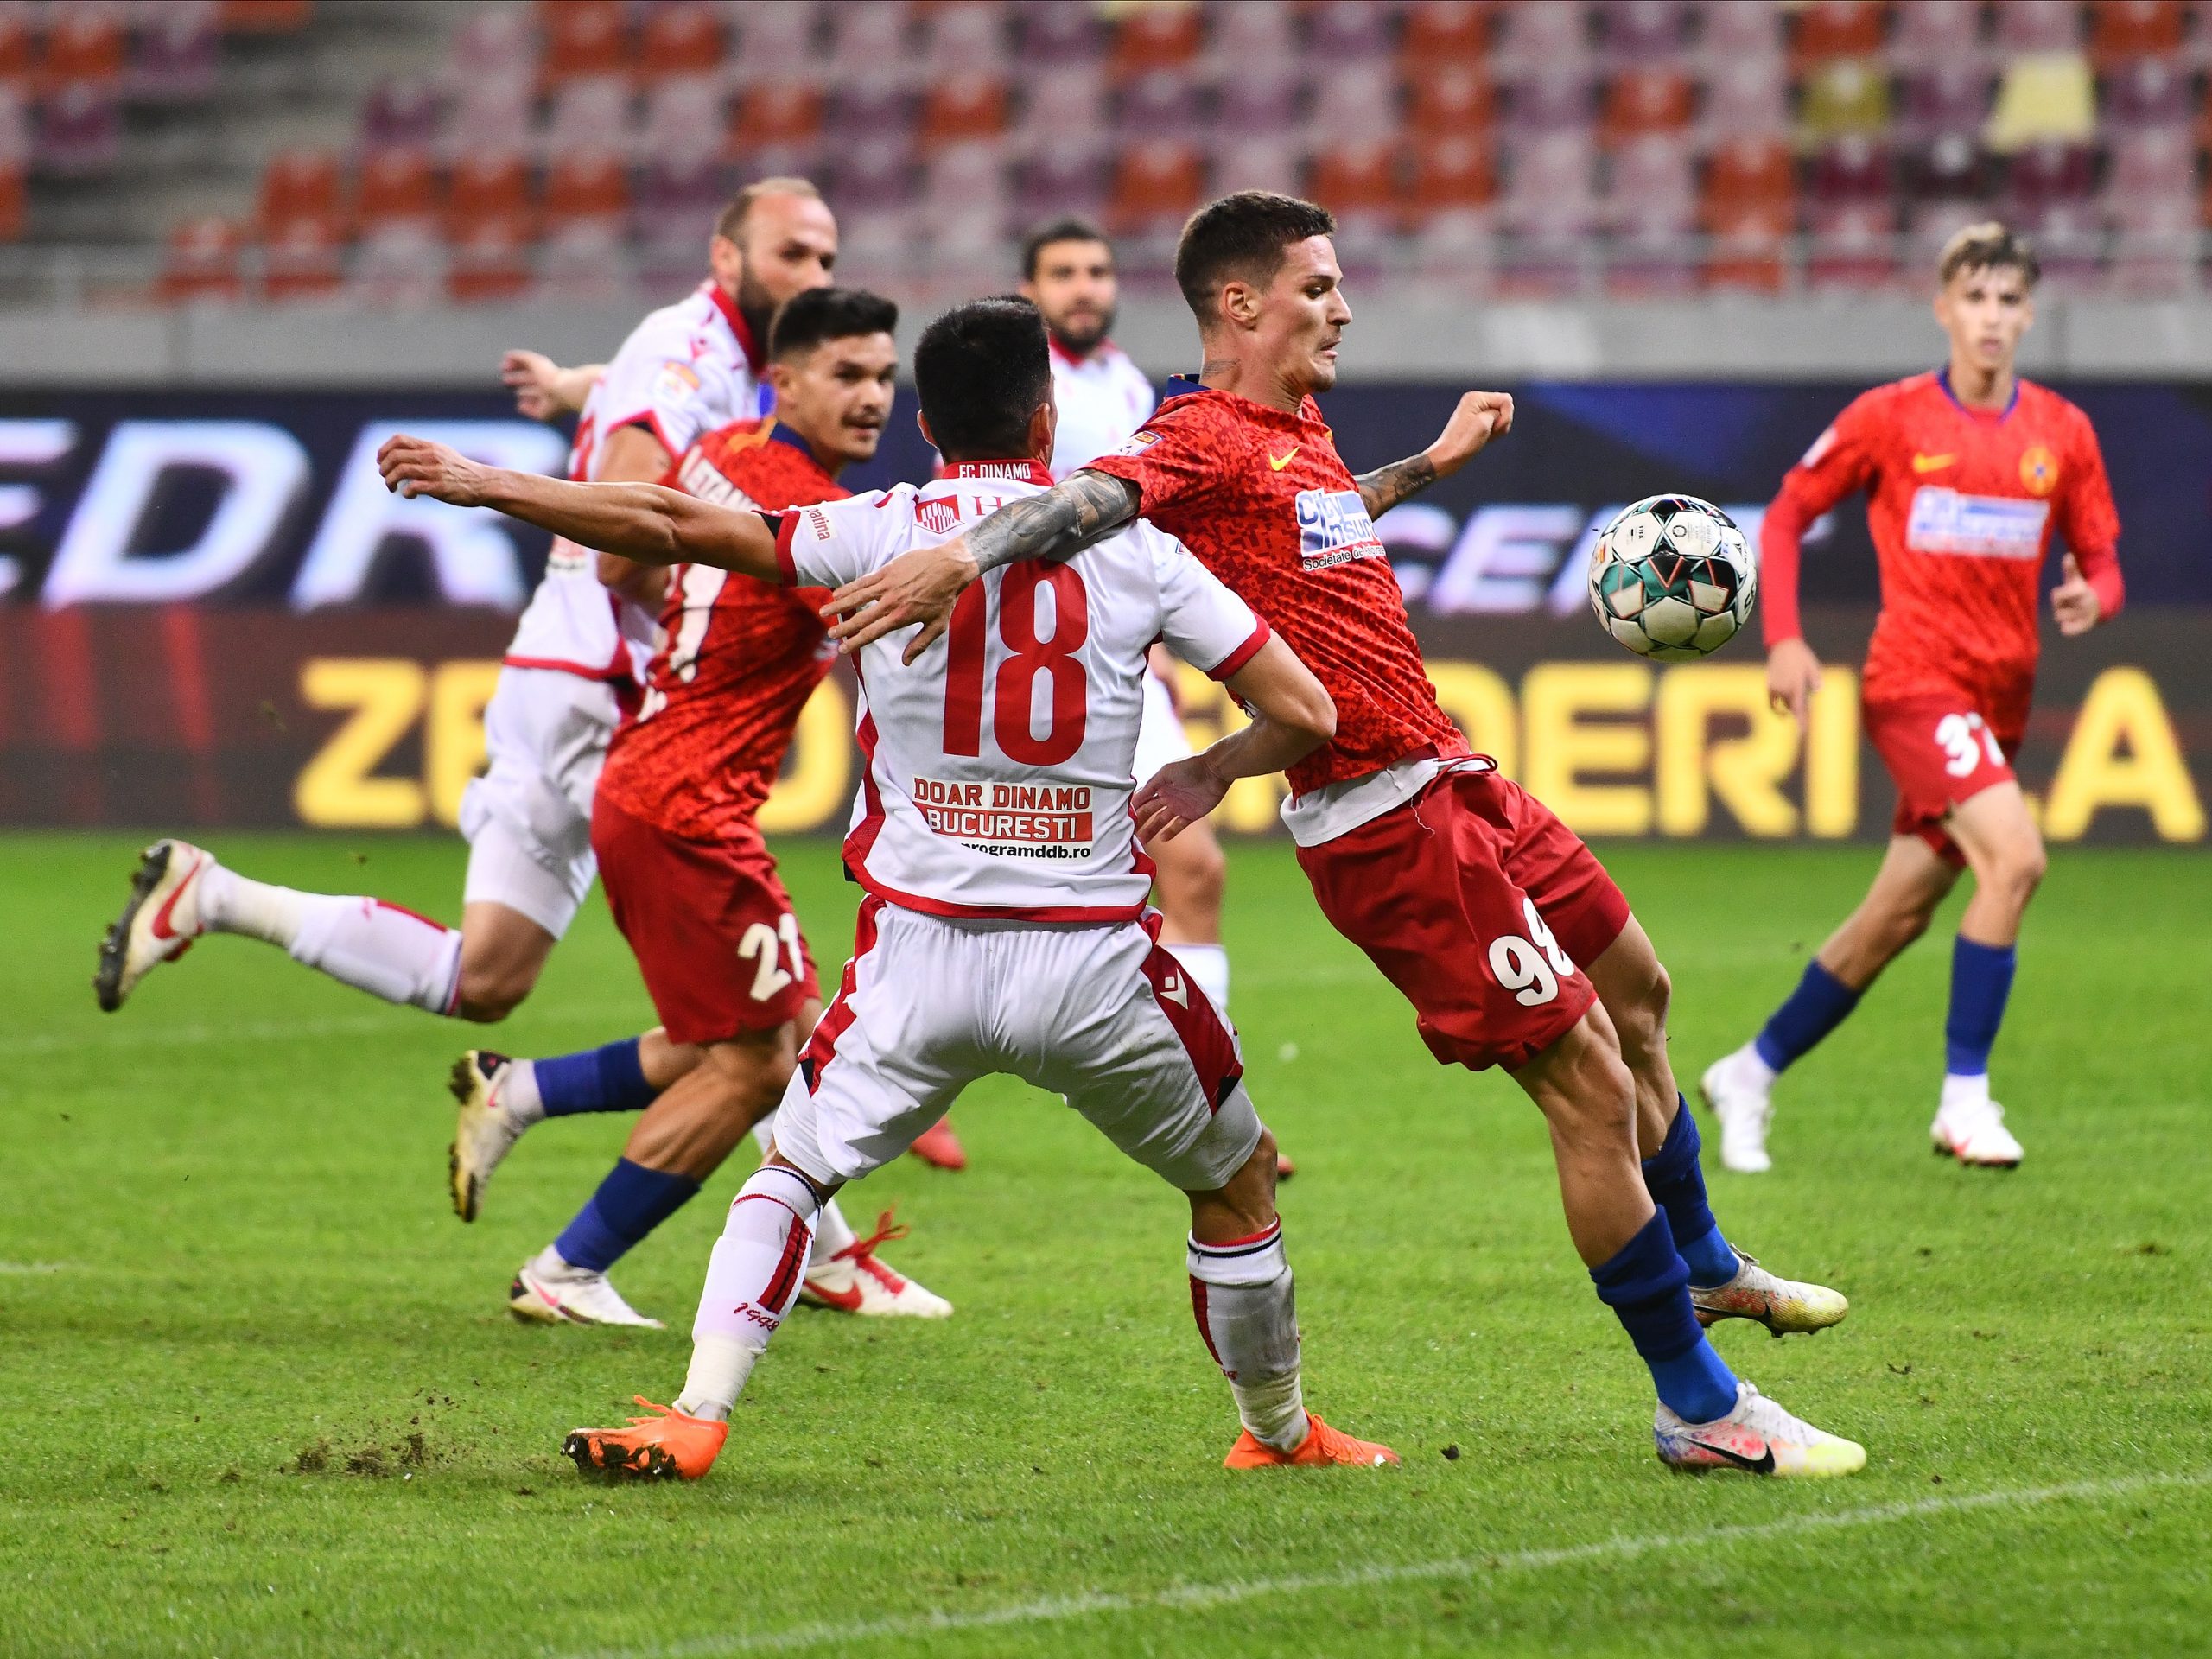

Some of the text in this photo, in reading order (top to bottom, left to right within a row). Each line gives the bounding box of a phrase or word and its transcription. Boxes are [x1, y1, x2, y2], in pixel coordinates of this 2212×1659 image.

[959, 463, 1032, 480] FC DINAMO
[1304, 550, 1351, 570] Societate
[943, 558, 1090, 766] 18
[914, 778, 1091, 810] DOAR DINAMO
[737, 912, 804, 1002] 21
